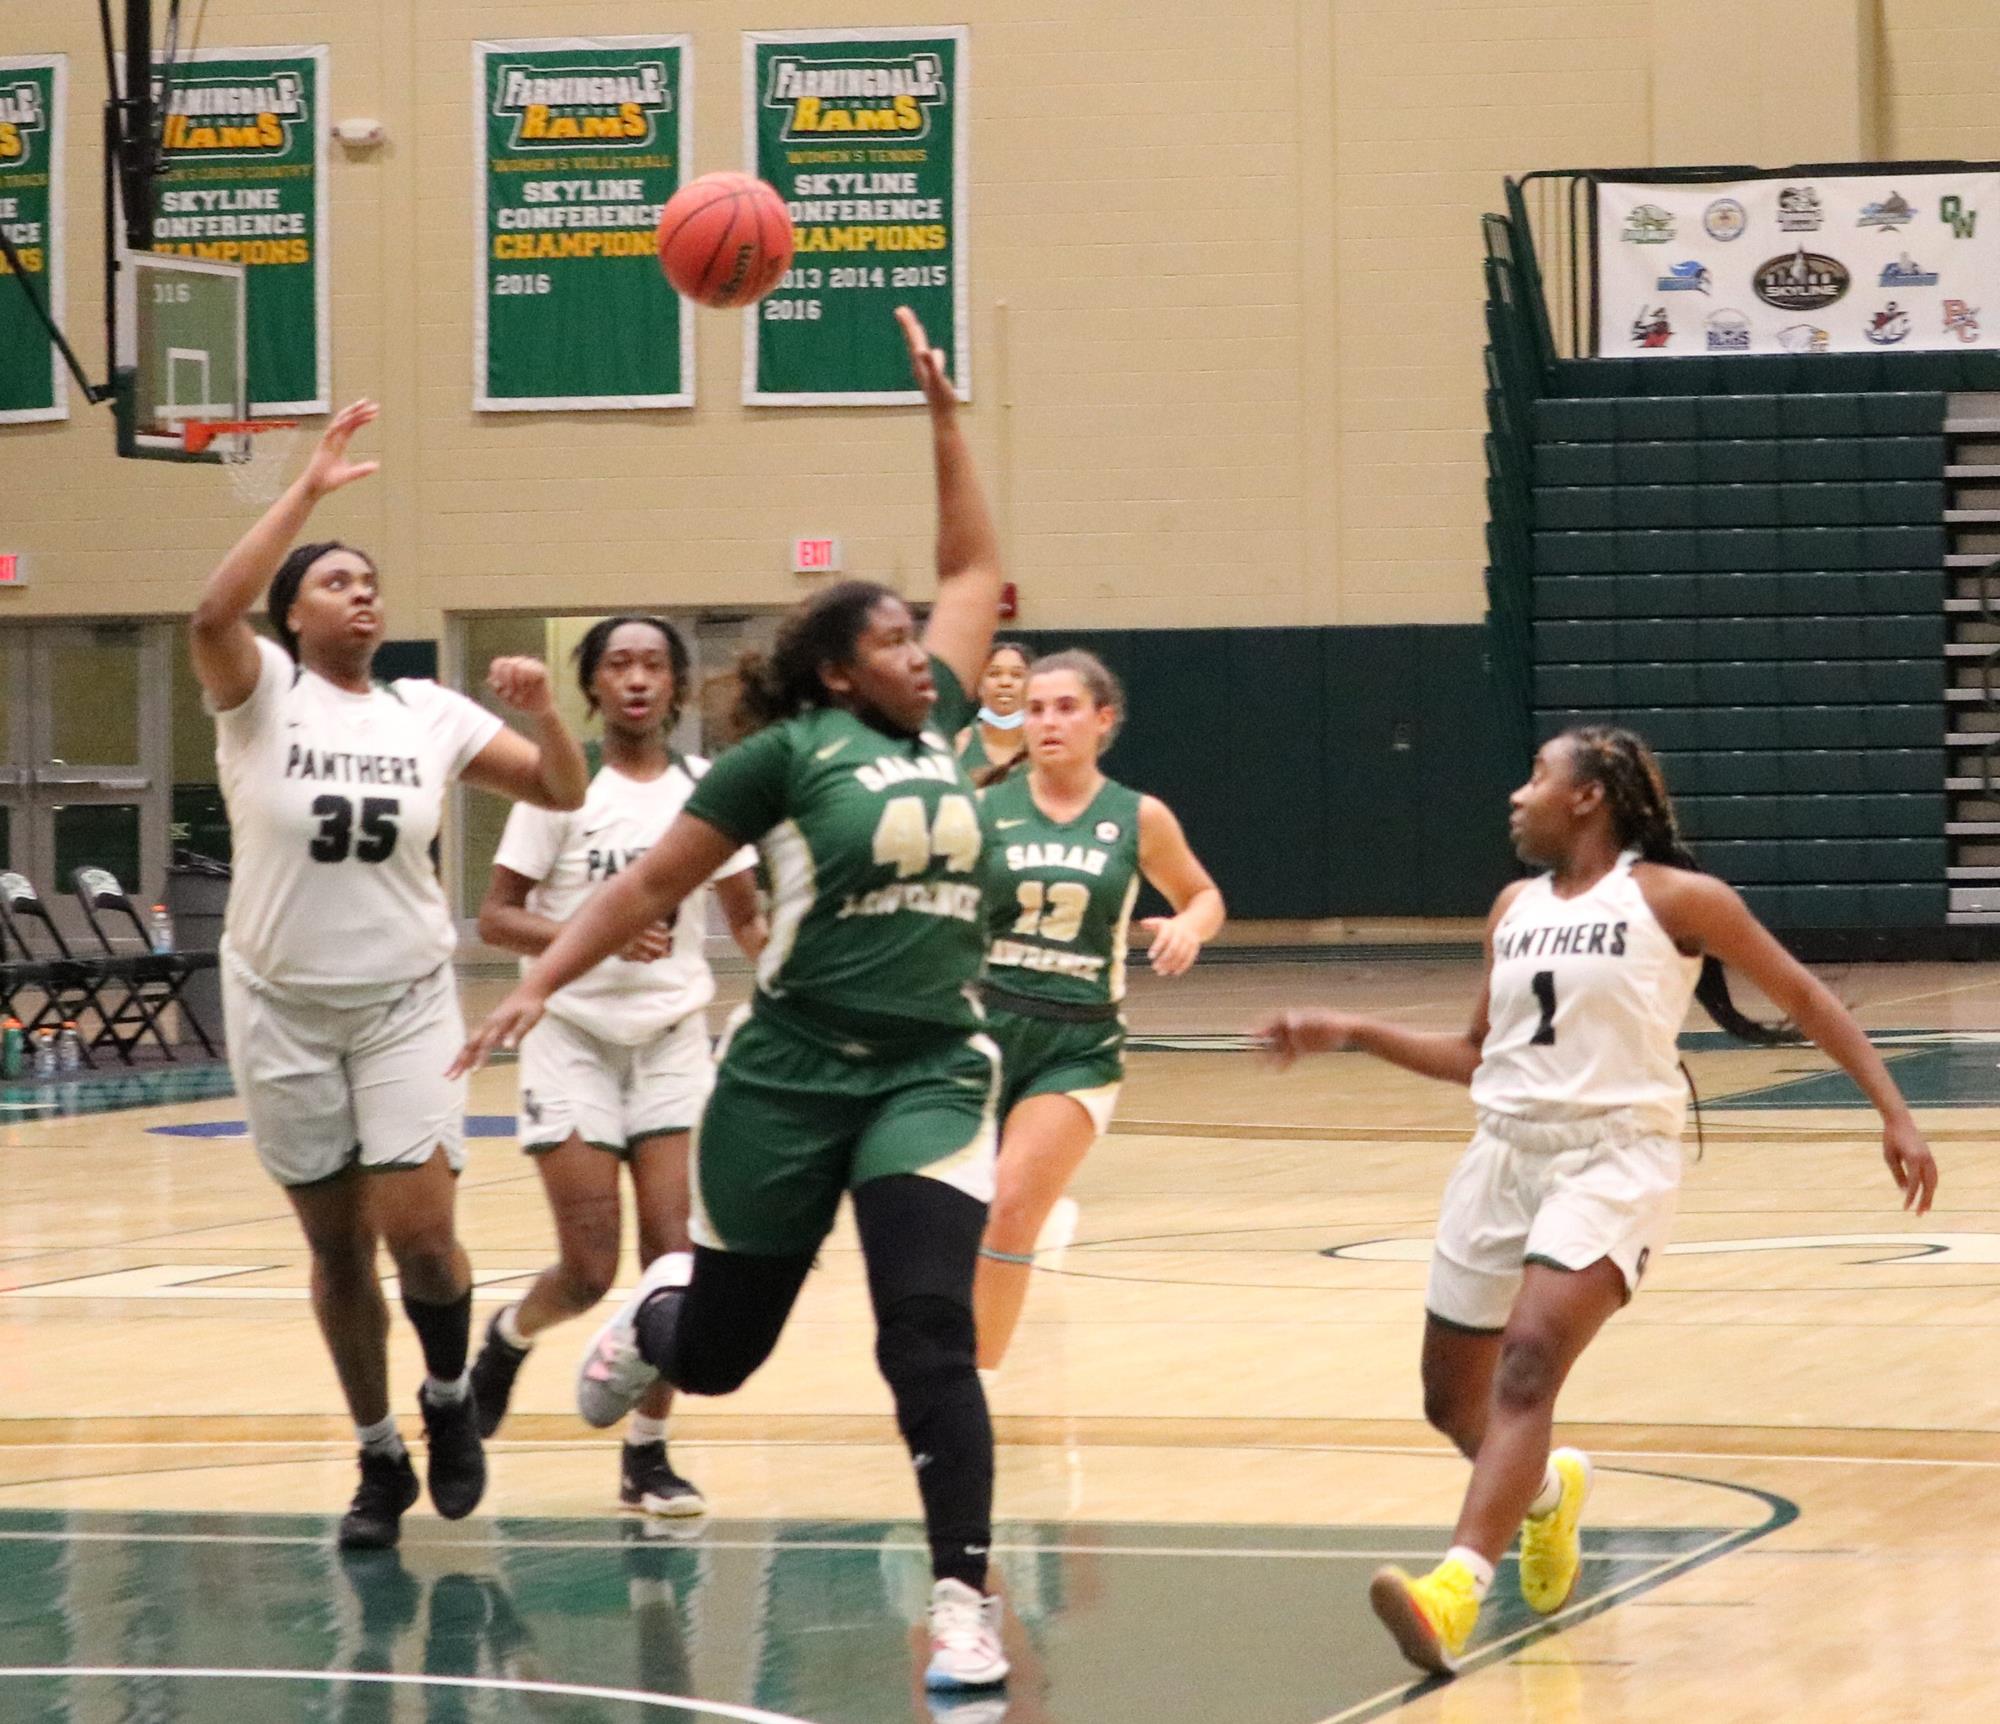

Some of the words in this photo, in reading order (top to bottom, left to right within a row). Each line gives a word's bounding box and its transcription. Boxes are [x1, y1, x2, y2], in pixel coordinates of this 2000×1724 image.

[520, 102, 647, 139] RAMS
[792, 94, 922, 132] RAMS
[523, 180, 644, 202] SKYLINE
[794, 173, 918, 195] SKYLINE
[161, 189, 281, 212] SKYLINE
[788, 199, 942, 223] ONFERENCE
[153, 213, 306, 239] ONFERENCE
[791, 225, 946, 252] HAMPIONS
[494, 274, 551, 295] 2016
[778, 267, 822, 290] 013
[829, 267, 885, 288] 2014
[891, 266, 947, 287] 2015
[1765, 285, 1839, 297] SKYLINE
[763, 299, 821, 321] 2016
[799, 540, 833, 567] EXIT
[285, 743, 422, 788] PANTHERS
[309, 794, 400, 864] 35
[872, 794, 982, 878] 44
[1011, 880, 1091, 943] 13
[1529, 970, 1557, 1046] 1
